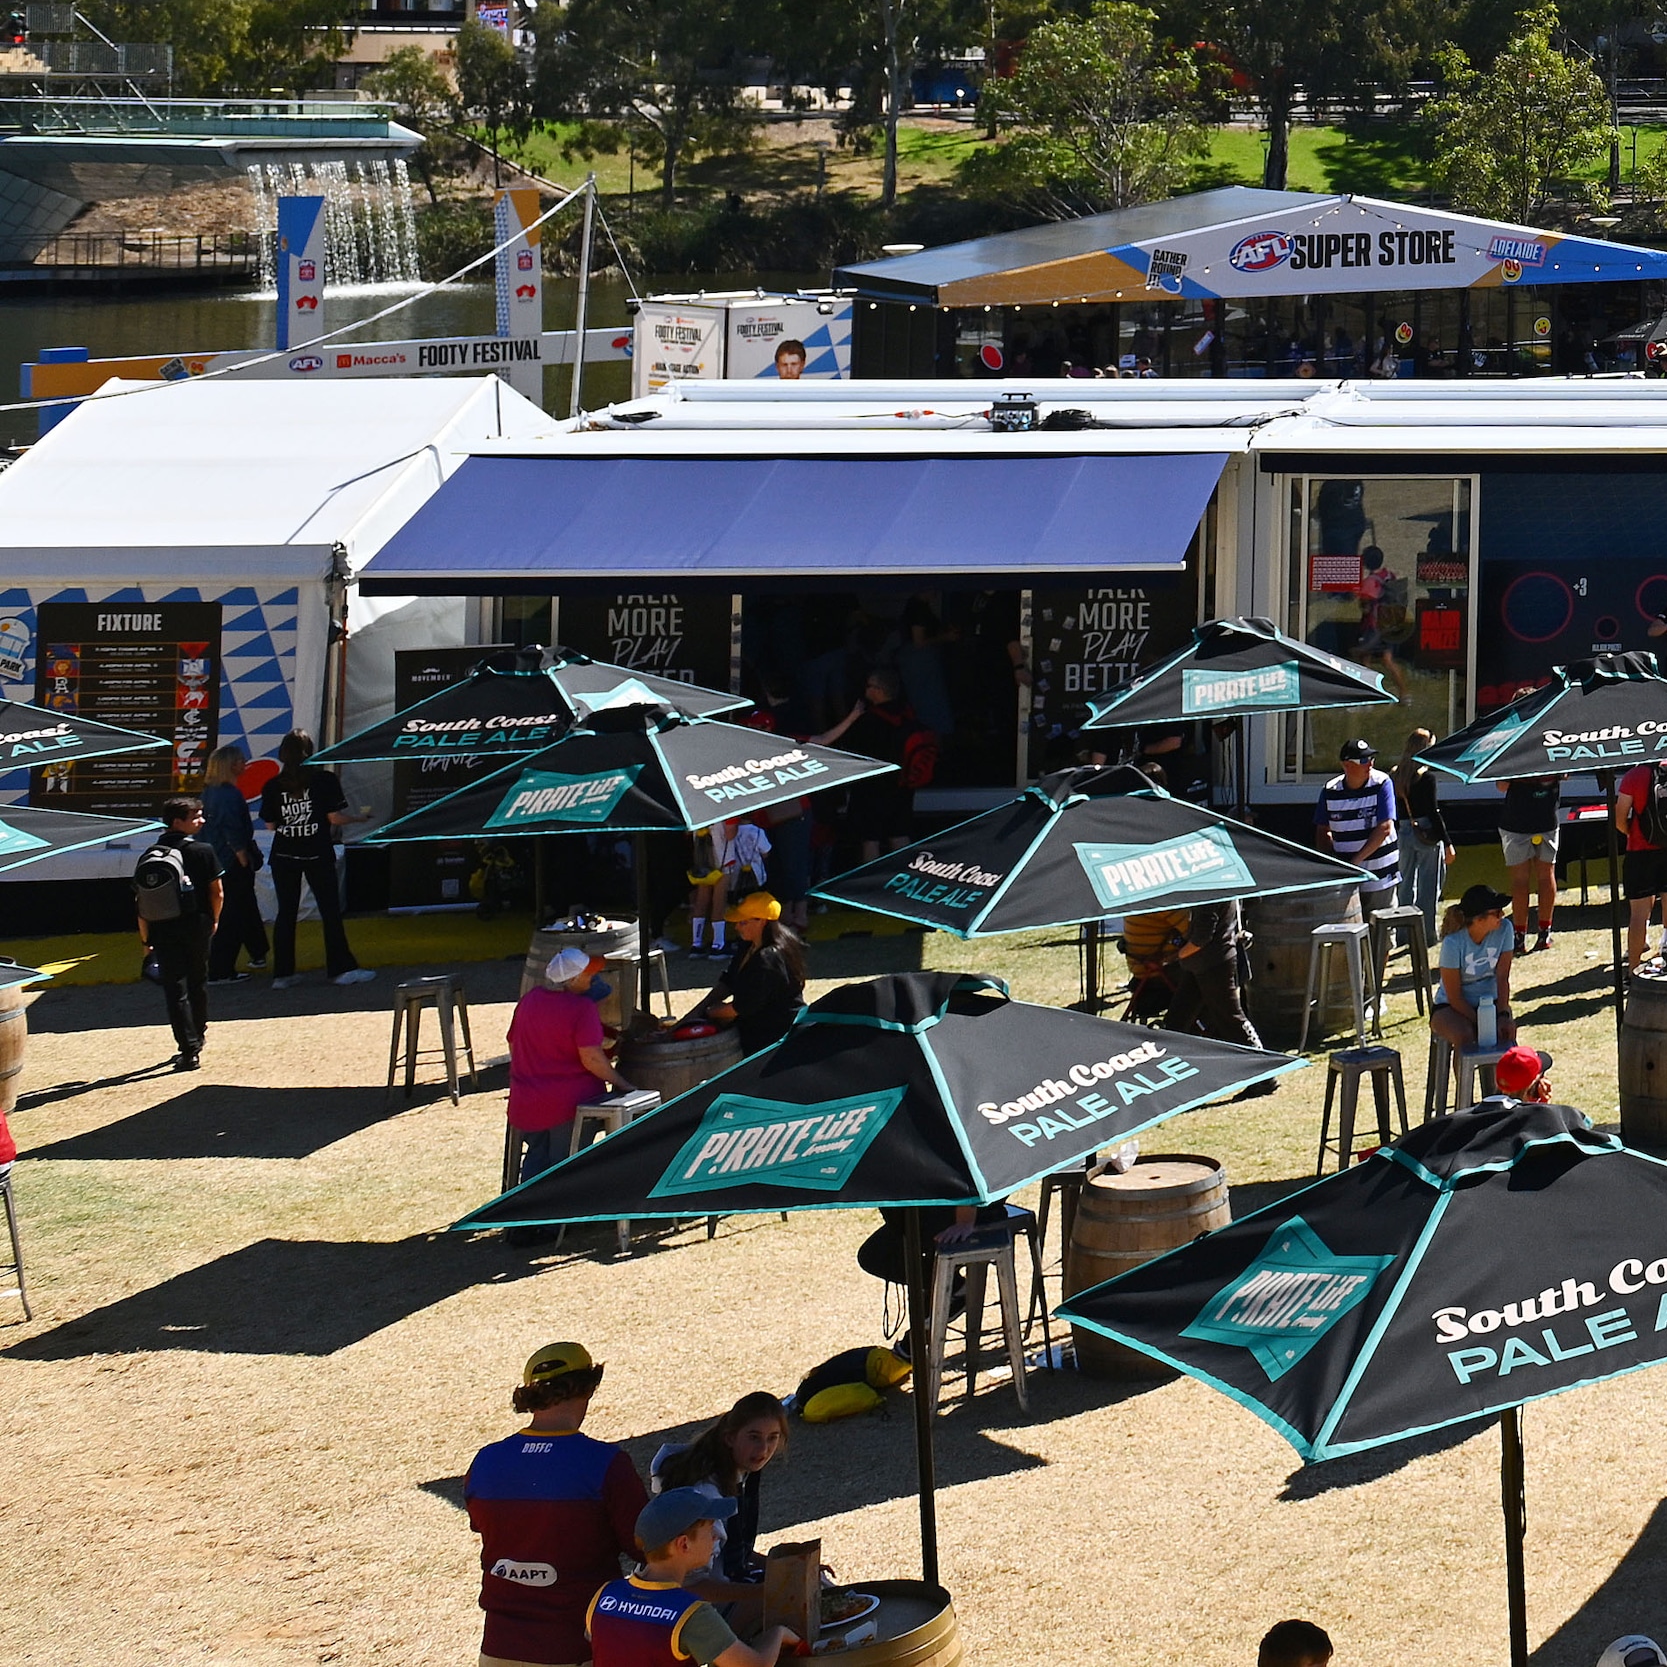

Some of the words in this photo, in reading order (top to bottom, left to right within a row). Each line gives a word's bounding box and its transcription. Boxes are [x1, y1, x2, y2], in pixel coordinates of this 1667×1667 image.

[1153, 249, 1188, 267] GATHER
[1237, 237, 1292, 269] AFL
[1291, 234, 1371, 270] SUPER
[1379, 230, 1455, 266] STORE
[1491, 239, 1541, 260] ADELAIDE
[655, 324, 675, 341] FOOTY
[676, 324, 702, 342] FESTIVAL
[736, 324, 756, 335] FOOTY
[757, 321, 784, 333] FESTIVAL
[291, 357, 321, 371] AFL
[353, 352, 406, 366] Macca's
[418, 344, 467, 367] FOOTY
[473, 339, 541, 363] FESTIVAL
[1572, 576, 1588, 596] +3
[97, 614, 162, 632] FIXTURE
[608, 607, 684, 637] MORE
[1078, 602, 1150, 631] MORE
[611, 637, 681, 667] PLAY
[1082, 631, 1148, 662] PLAY
[411, 673, 453, 682] MOVEMBER
[392, 731, 479, 748] PALE
[483, 725, 551, 744] ALE
[402, 716, 483, 733] South
[486, 713, 558, 729] Coast
[1542, 718, 1633, 748] South
[11, 734, 83, 758] ALE
[1546, 735, 1645, 762] PALE
[684, 765, 746, 792] South
[749, 749, 810, 777] Coast
[704, 772, 773, 803] PALE
[776, 757, 829, 788] ALE
[908, 851, 963, 883] South
[958, 864, 1004, 888] Coast
[884, 872, 942, 906] PALE
[938, 884, 983, 910] ALE
[976, 1073, 1077, 1126] South
[1066, 1040, 1167, 1091] Coast
[1007, 1091, 1121, 1148] PALE
[1119, 1054, 1200, 1108] ALE
[1432, 1278, 1605, 1345] South
[1447, 1307, 1640, 1386] PALE
[508, 1569, 548, 1580] AAPT
[617, 1600, 679, 1621] HYUNDAI
